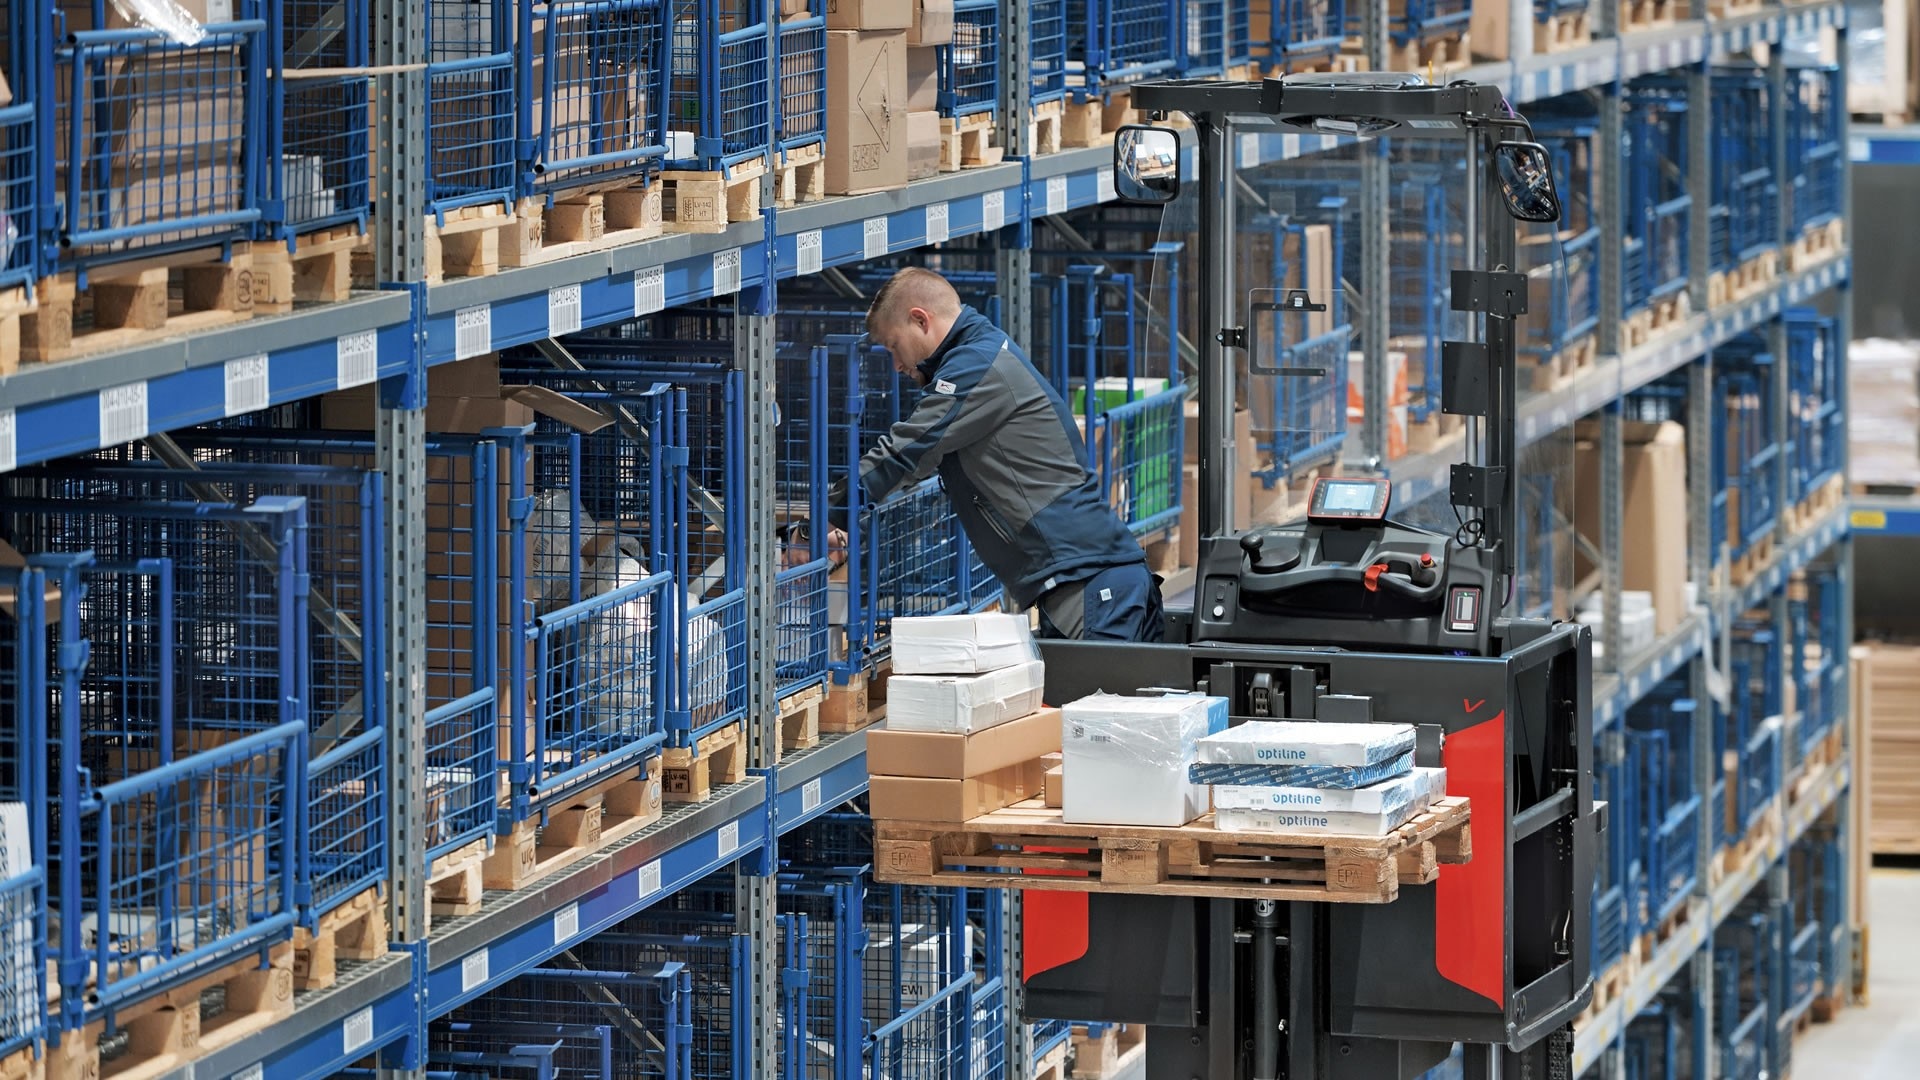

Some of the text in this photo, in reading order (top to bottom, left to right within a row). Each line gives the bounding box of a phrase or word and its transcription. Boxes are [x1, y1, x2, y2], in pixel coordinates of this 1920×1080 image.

[1257, 748, 1306, 760] optiline
[1272, 793, 1322, 805] optiline
[1278, 815, 1328, 827] optiline
[901, 985, 923, 996] EWI
